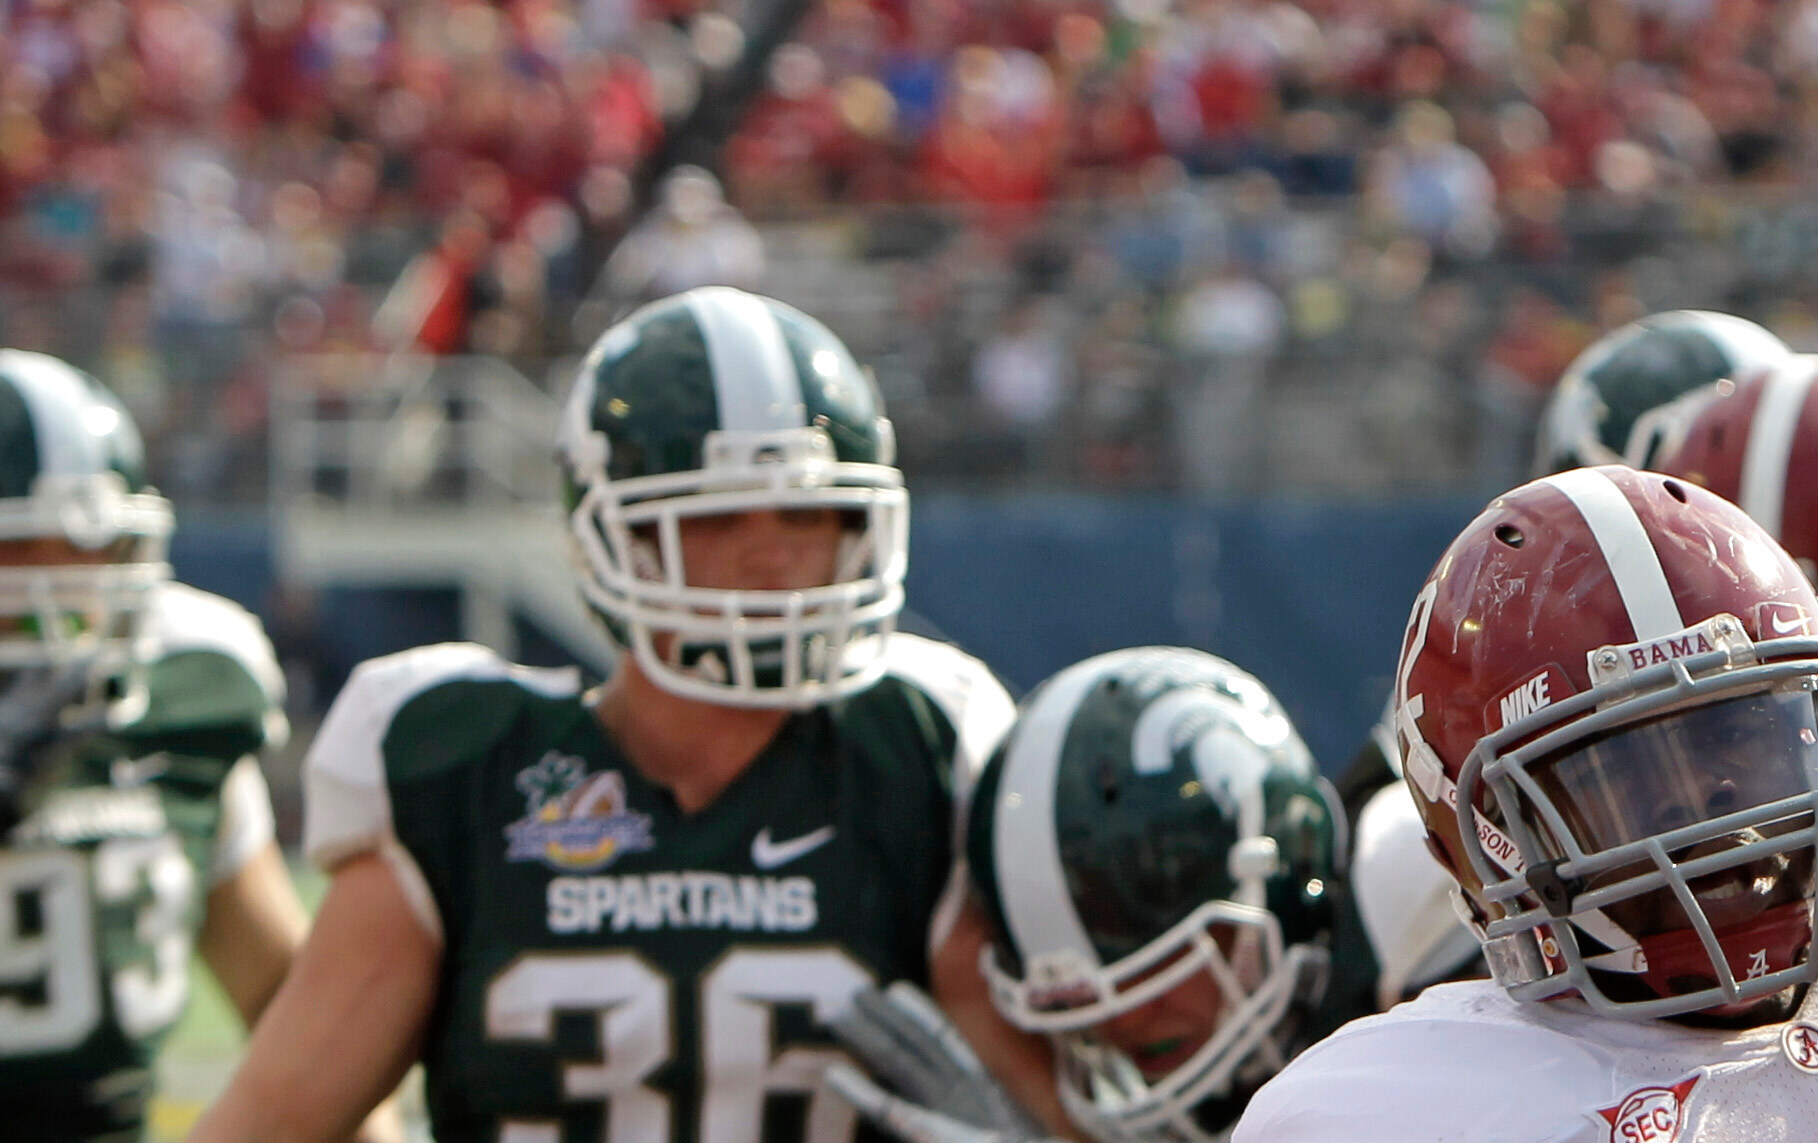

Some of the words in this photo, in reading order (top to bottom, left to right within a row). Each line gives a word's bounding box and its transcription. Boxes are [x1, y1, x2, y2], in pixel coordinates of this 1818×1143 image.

[1628, 632, 1714, 670] BAMA
[1500, 670, 1551, 729] NIKE
[547, 873, 817, 933] SPARTANS
[0, 845, 196, 1044] 93
